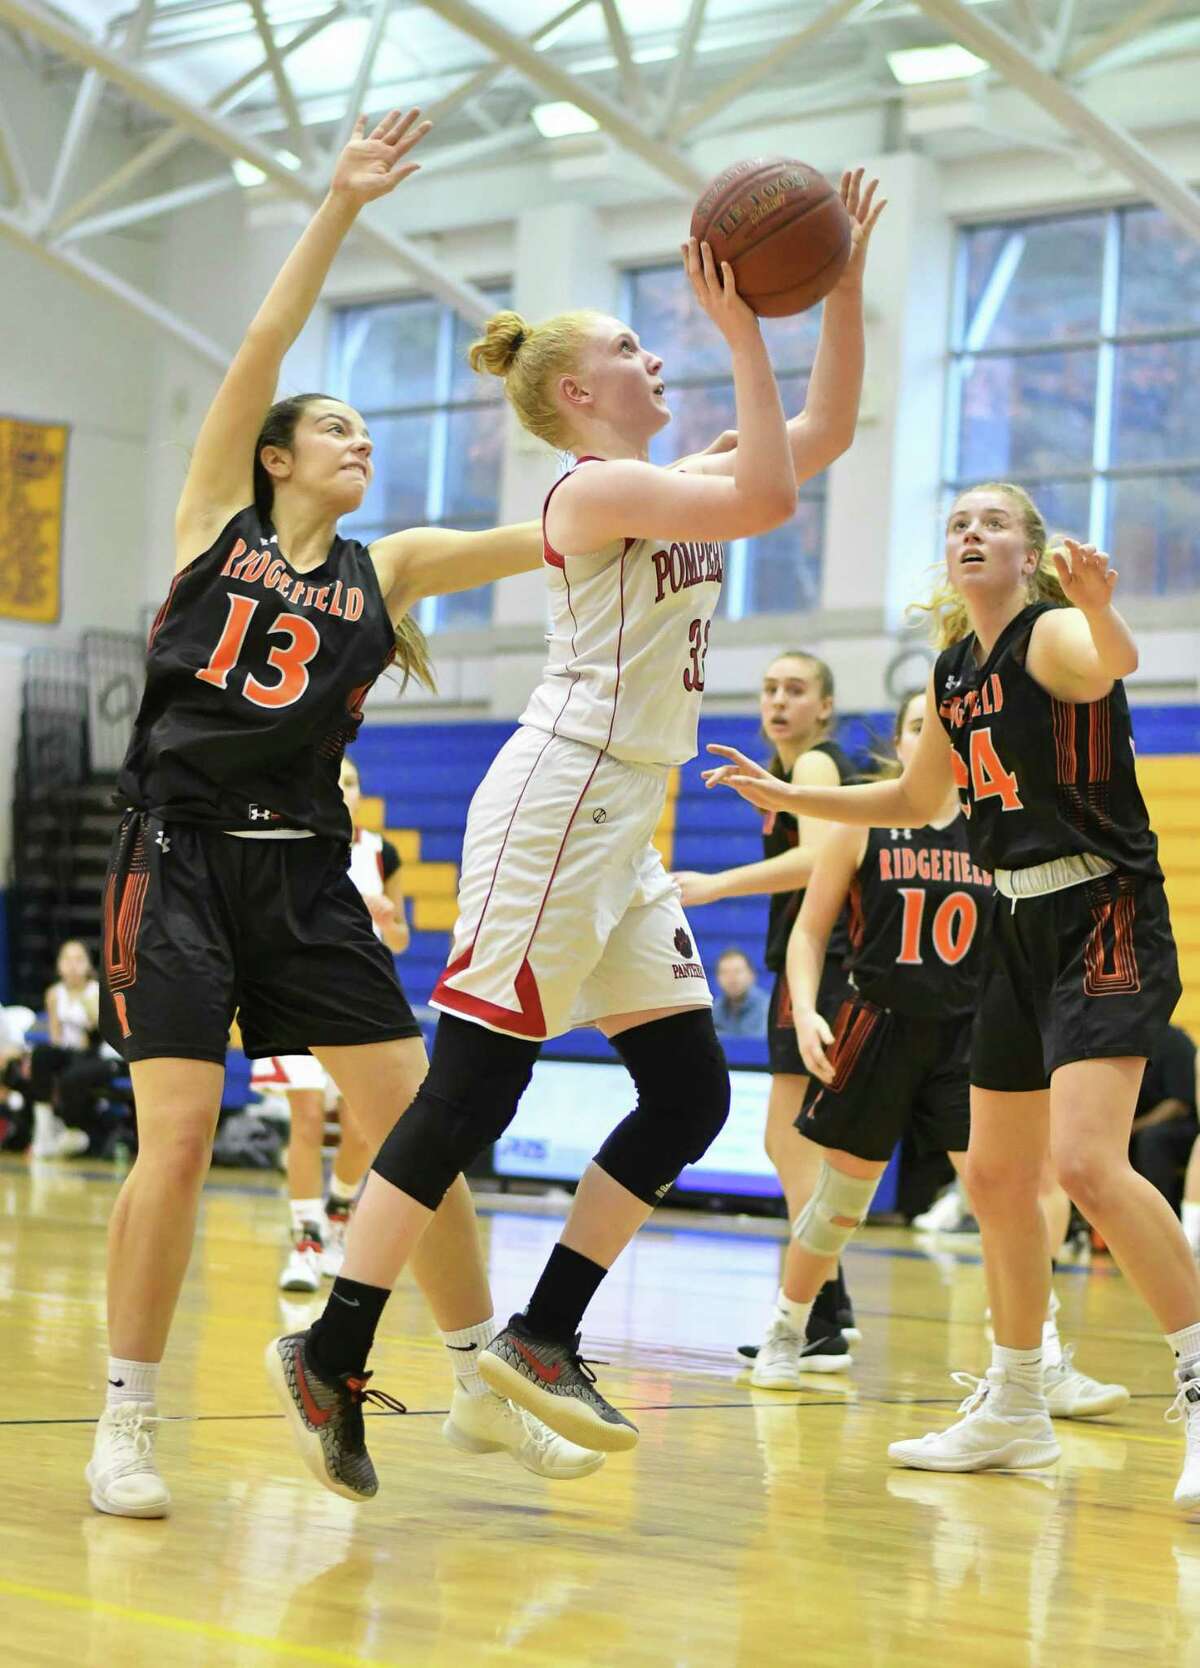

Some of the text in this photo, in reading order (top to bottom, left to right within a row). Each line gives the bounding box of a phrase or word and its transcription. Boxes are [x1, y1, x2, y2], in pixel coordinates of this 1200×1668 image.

[219, 538, 365, 622] RIDGEFIELD
[195, 592, 320, 709] 13
[896, 888, 978, 965] 10
